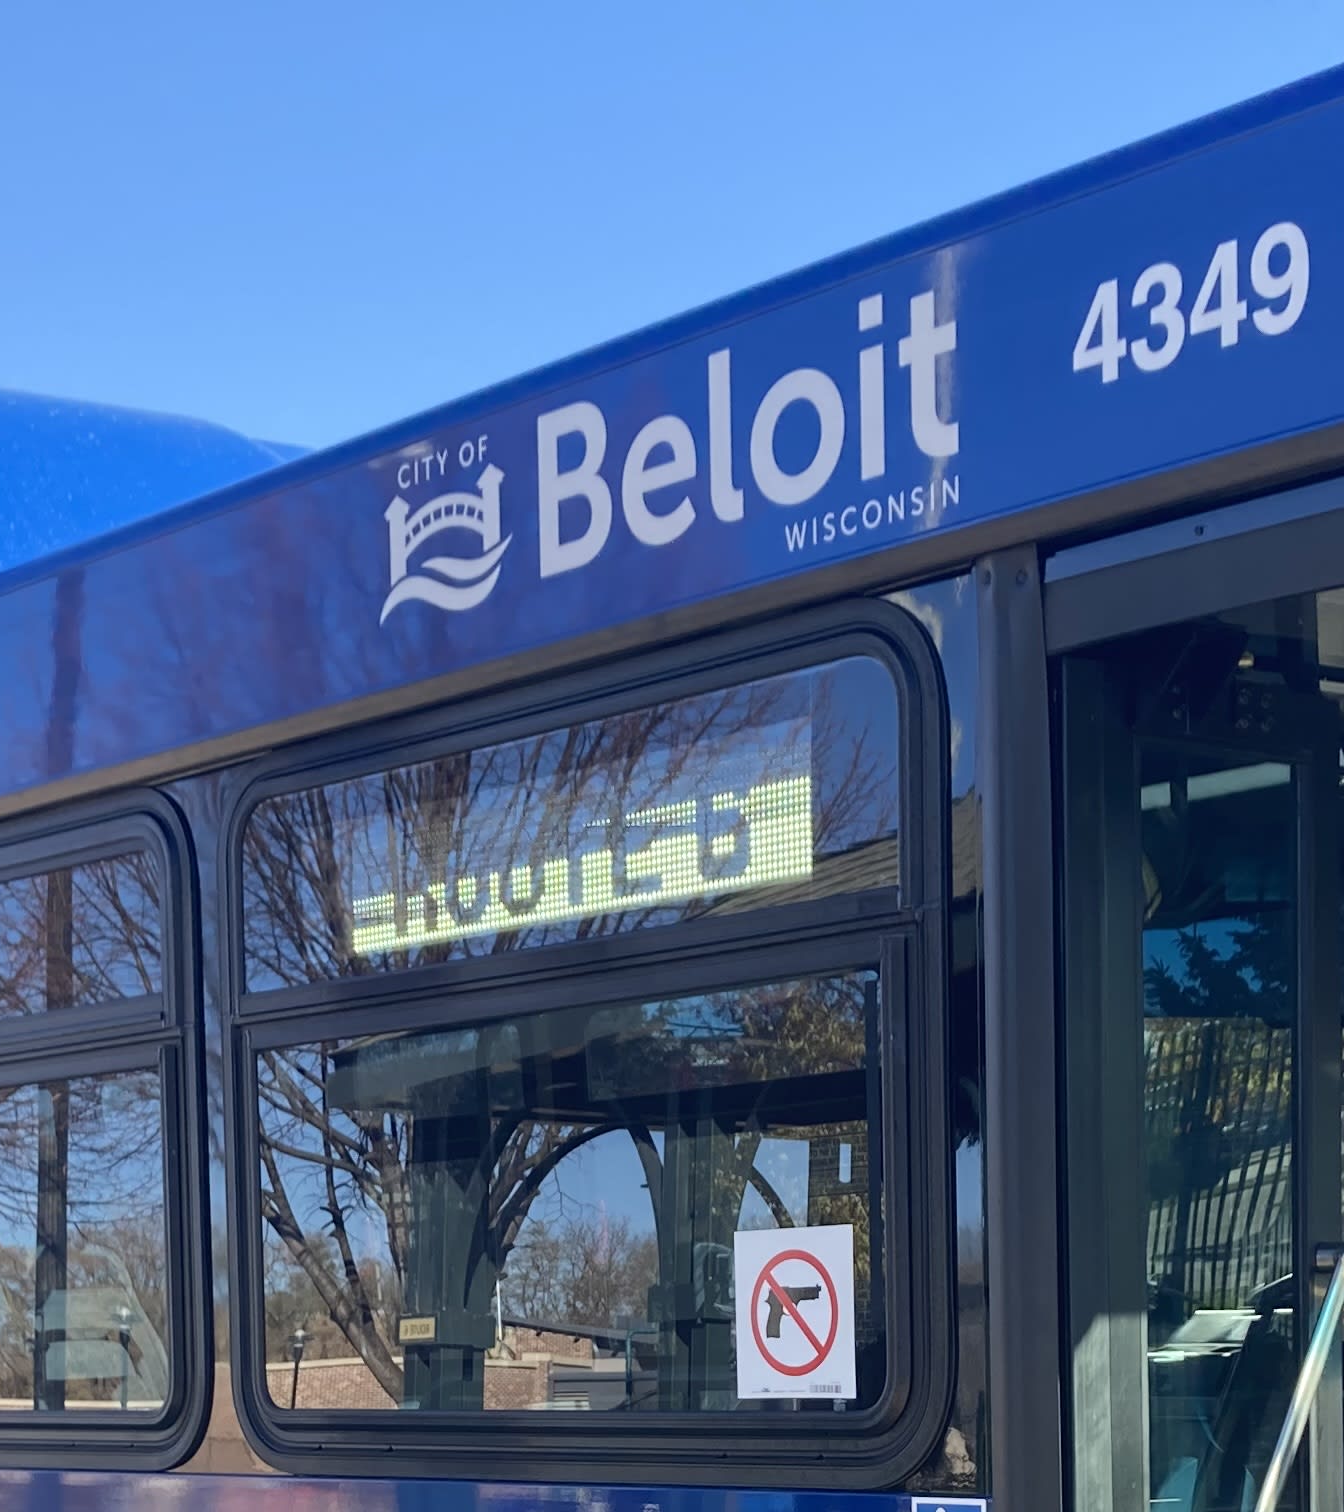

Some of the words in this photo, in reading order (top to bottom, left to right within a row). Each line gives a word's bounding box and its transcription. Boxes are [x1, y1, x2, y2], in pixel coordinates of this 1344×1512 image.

[1072, 222, 1309, 383] 4349
[396, 448, 449, 490] CITY
[458, 437, 489, 468] OF
[537, 289, 959, 579] Beloit
[785, 474, 962, 552] WISCONSIN
